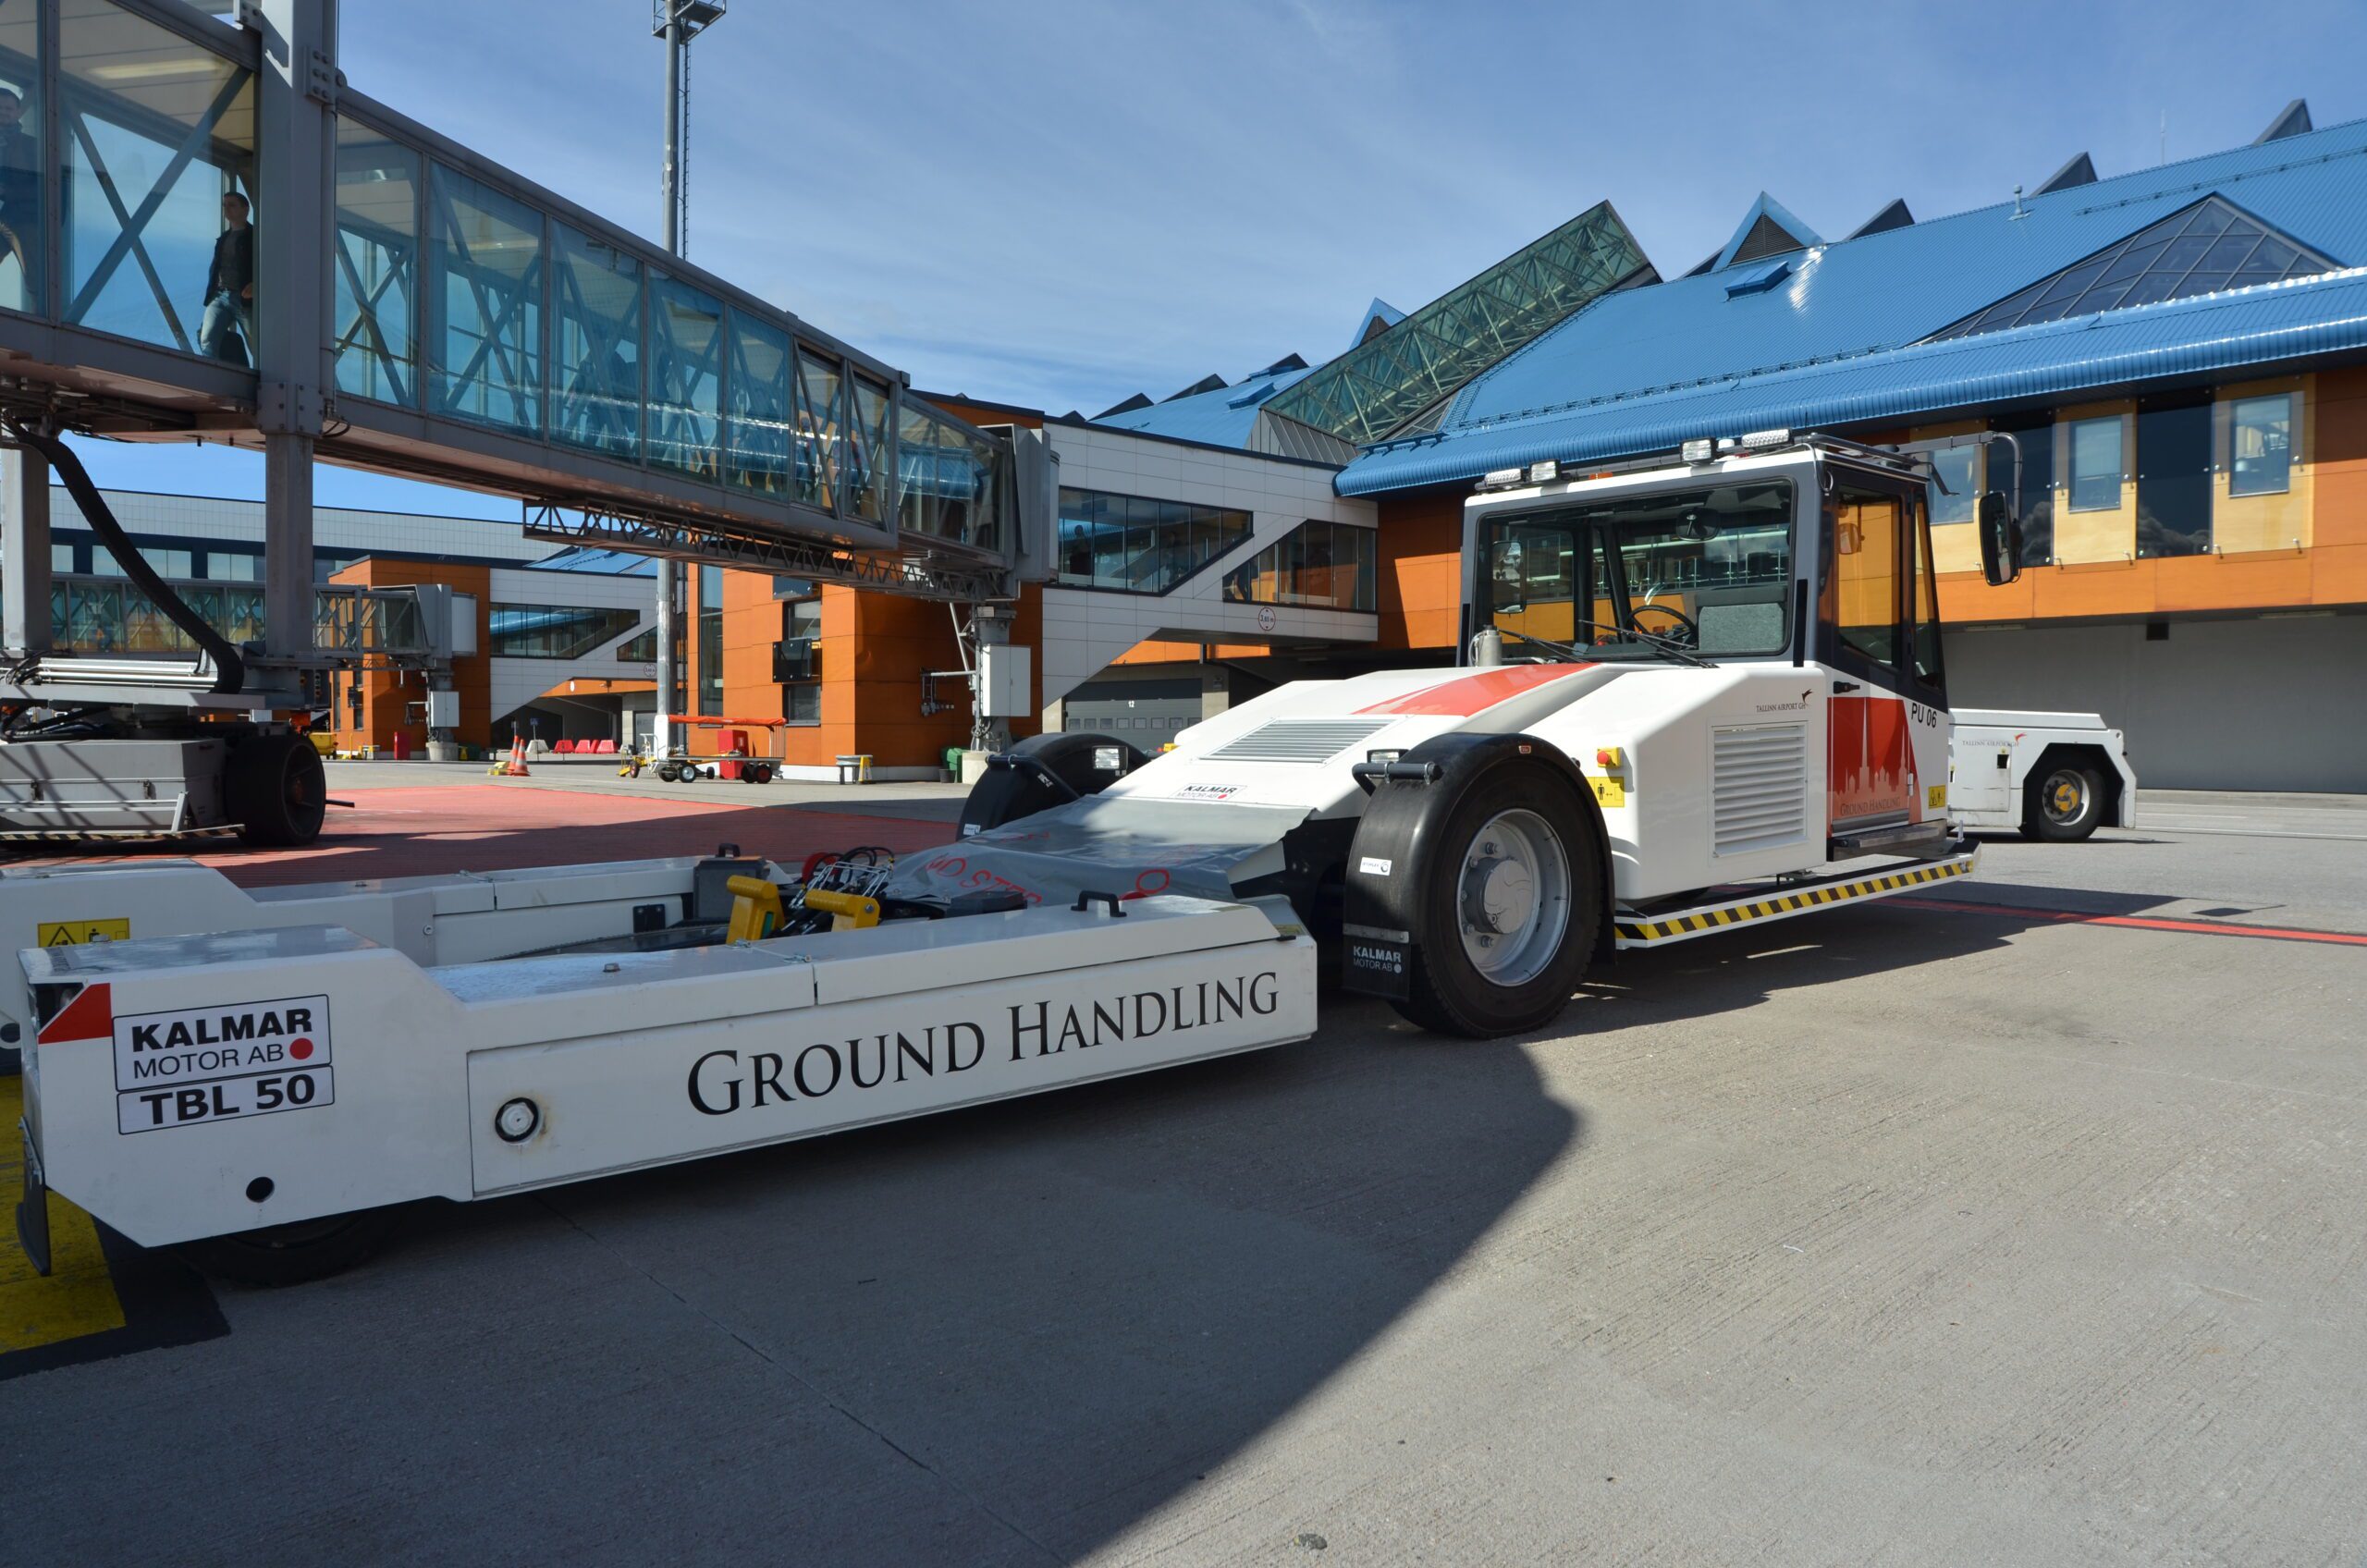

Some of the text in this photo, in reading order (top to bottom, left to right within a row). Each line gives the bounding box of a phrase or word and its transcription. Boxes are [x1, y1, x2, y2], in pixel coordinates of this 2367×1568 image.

[1777, 703, 1797, 711] AIRPORT
[1911, 702, 1938, 728] PU 06
[1184, 785, 1238, 793] KALMAR
[1841, 797, 1901, 815] GROUND HANDLING
[1353, 945, 1402, 962] KALMAR
[1353, 957, 1392, 972] MOTOR AB
[131, 1008, 313, 1052] KALMAR
[688, 972, 1280, 1116] GROUND HANDLING
[133, 1043, 285, 1079] MOTOR AB
[140, 1073, 315, 1125] TBL 50
